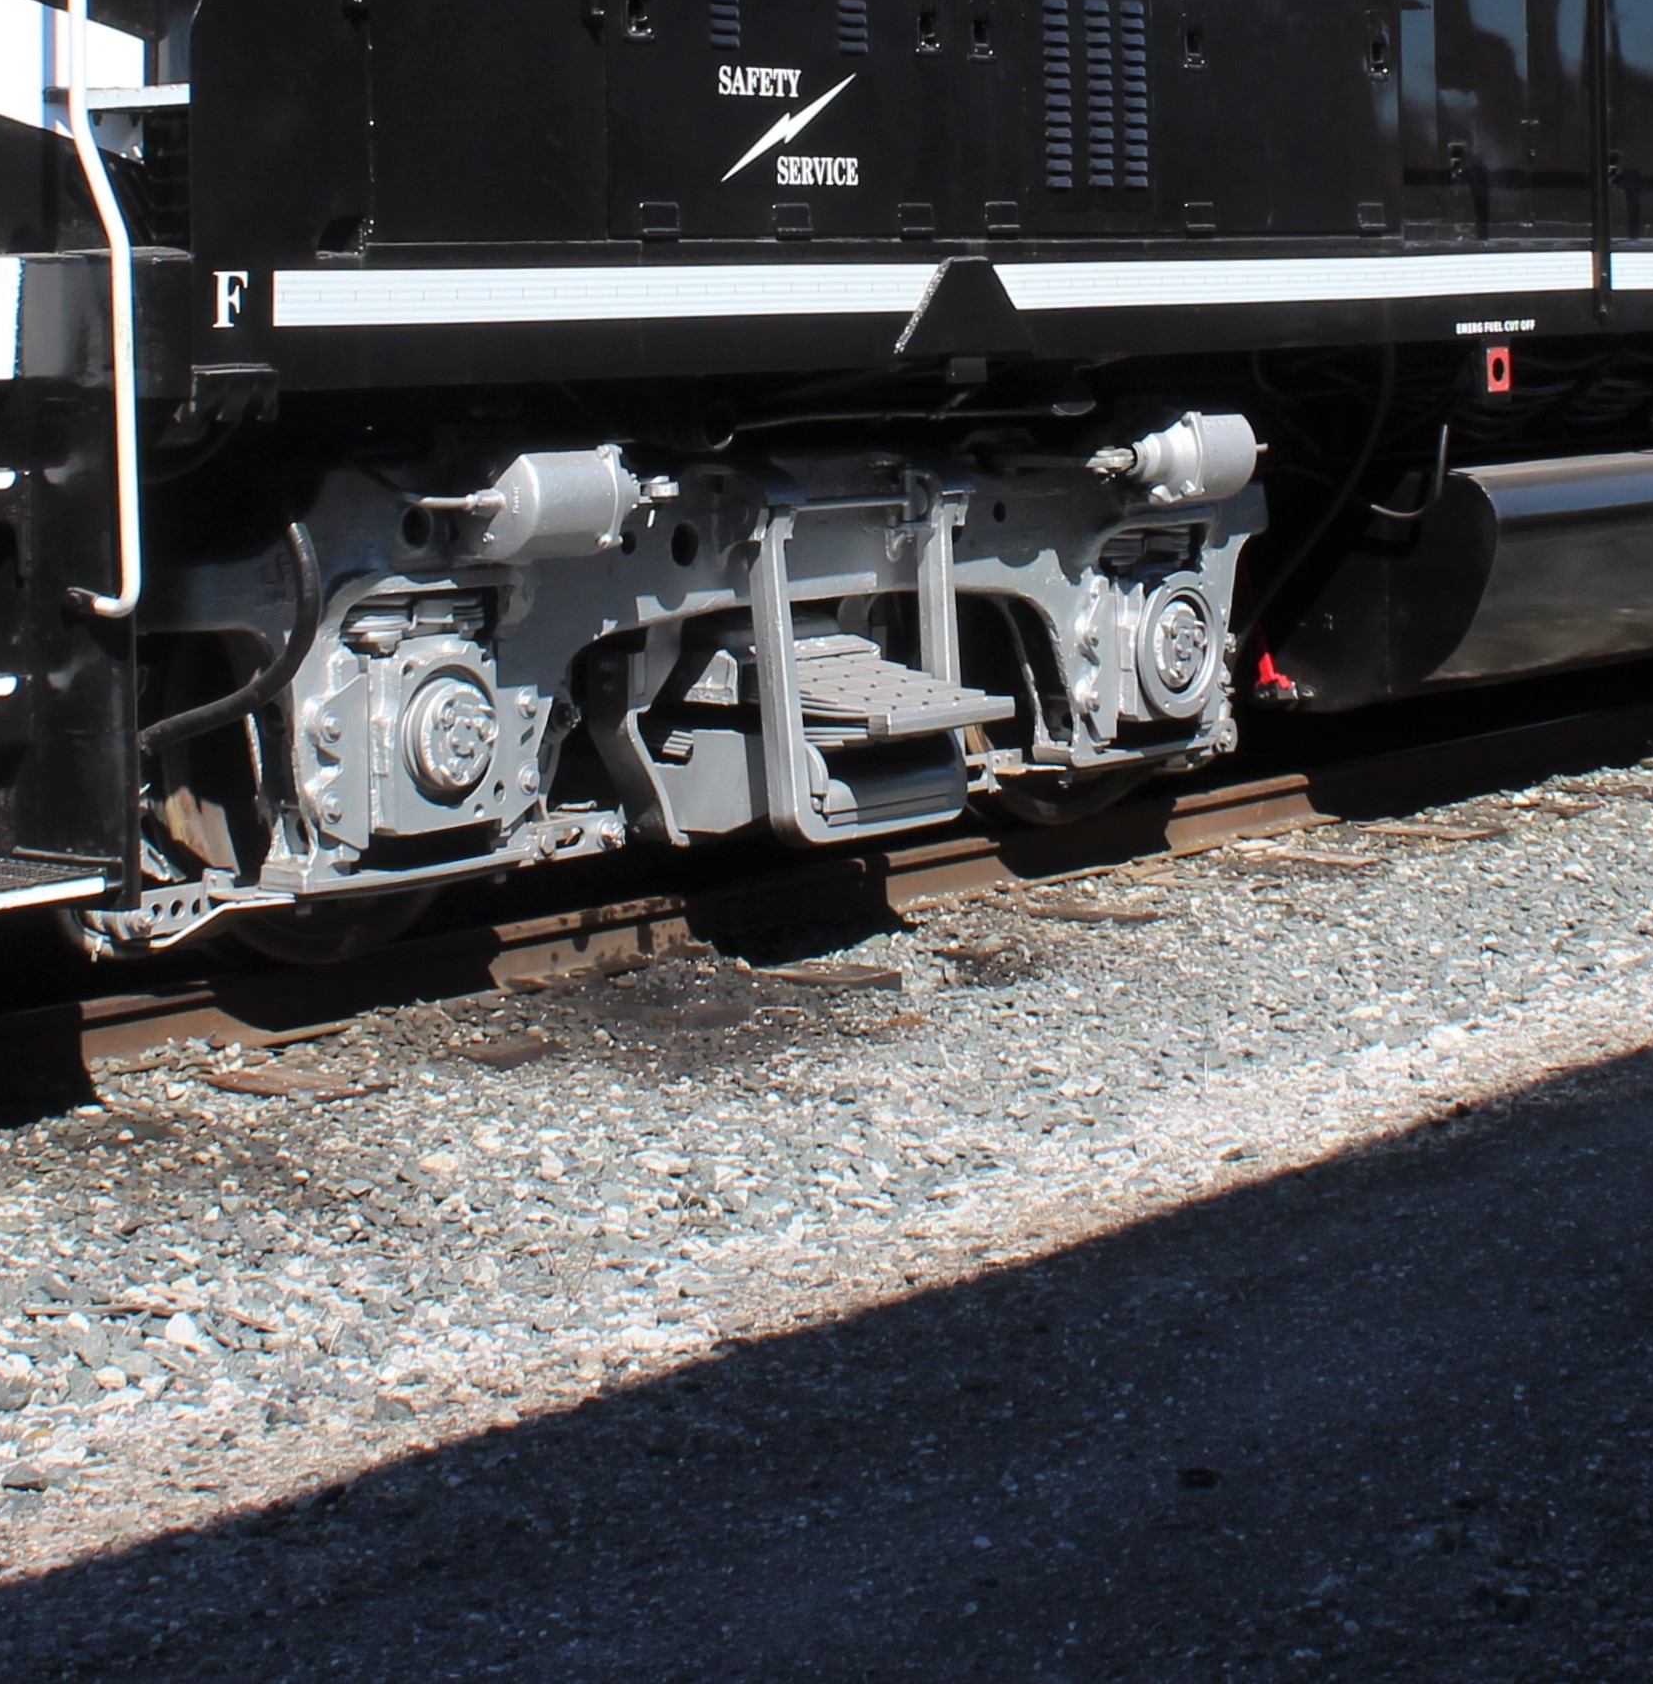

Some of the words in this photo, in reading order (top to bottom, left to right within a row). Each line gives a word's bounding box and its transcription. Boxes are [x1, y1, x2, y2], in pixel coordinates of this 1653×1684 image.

[718, 65, 802, 98] SAFETY
[776, 155, 859, 186] SERVICE
[212, 270, 249, 328] F
[1456, 322, 1483, 334] EMERG
[1484, 321, 1503, 333] FUEL
[1504, 320, 1519, 332] CUT
[1520, 319, 1536, 331] OFF
